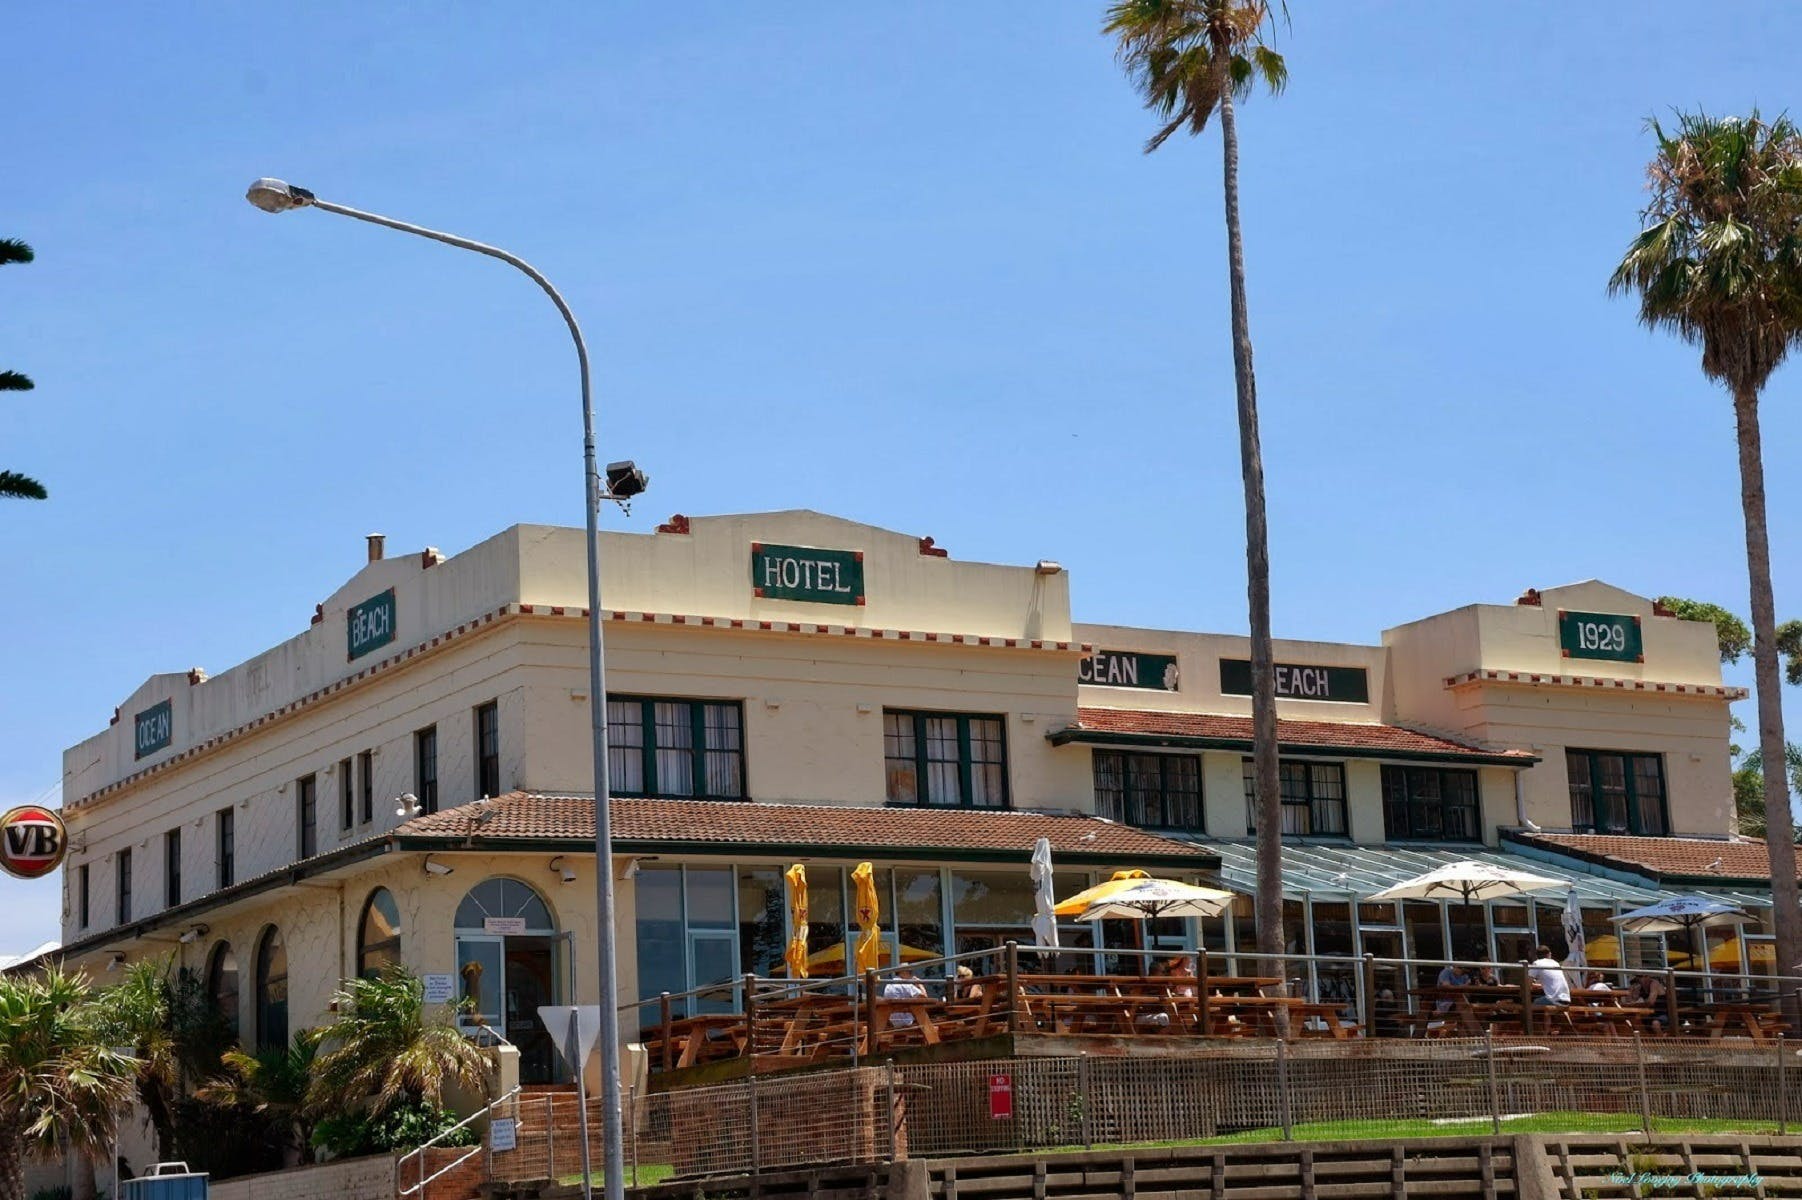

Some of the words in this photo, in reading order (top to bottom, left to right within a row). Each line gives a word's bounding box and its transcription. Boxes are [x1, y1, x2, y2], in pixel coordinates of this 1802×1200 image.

[764, 556, 851, 592] HOTEL
[353, 604, 389, 648] BEACH
[1578, 622, 1625, 651] 1929
[1079, 655, 1138, 684] CEAN
[1273, 667, 1329, 696] EACH
[139, 710, 169, 749] OCEAN
[5, 825, 58, 856] VB
